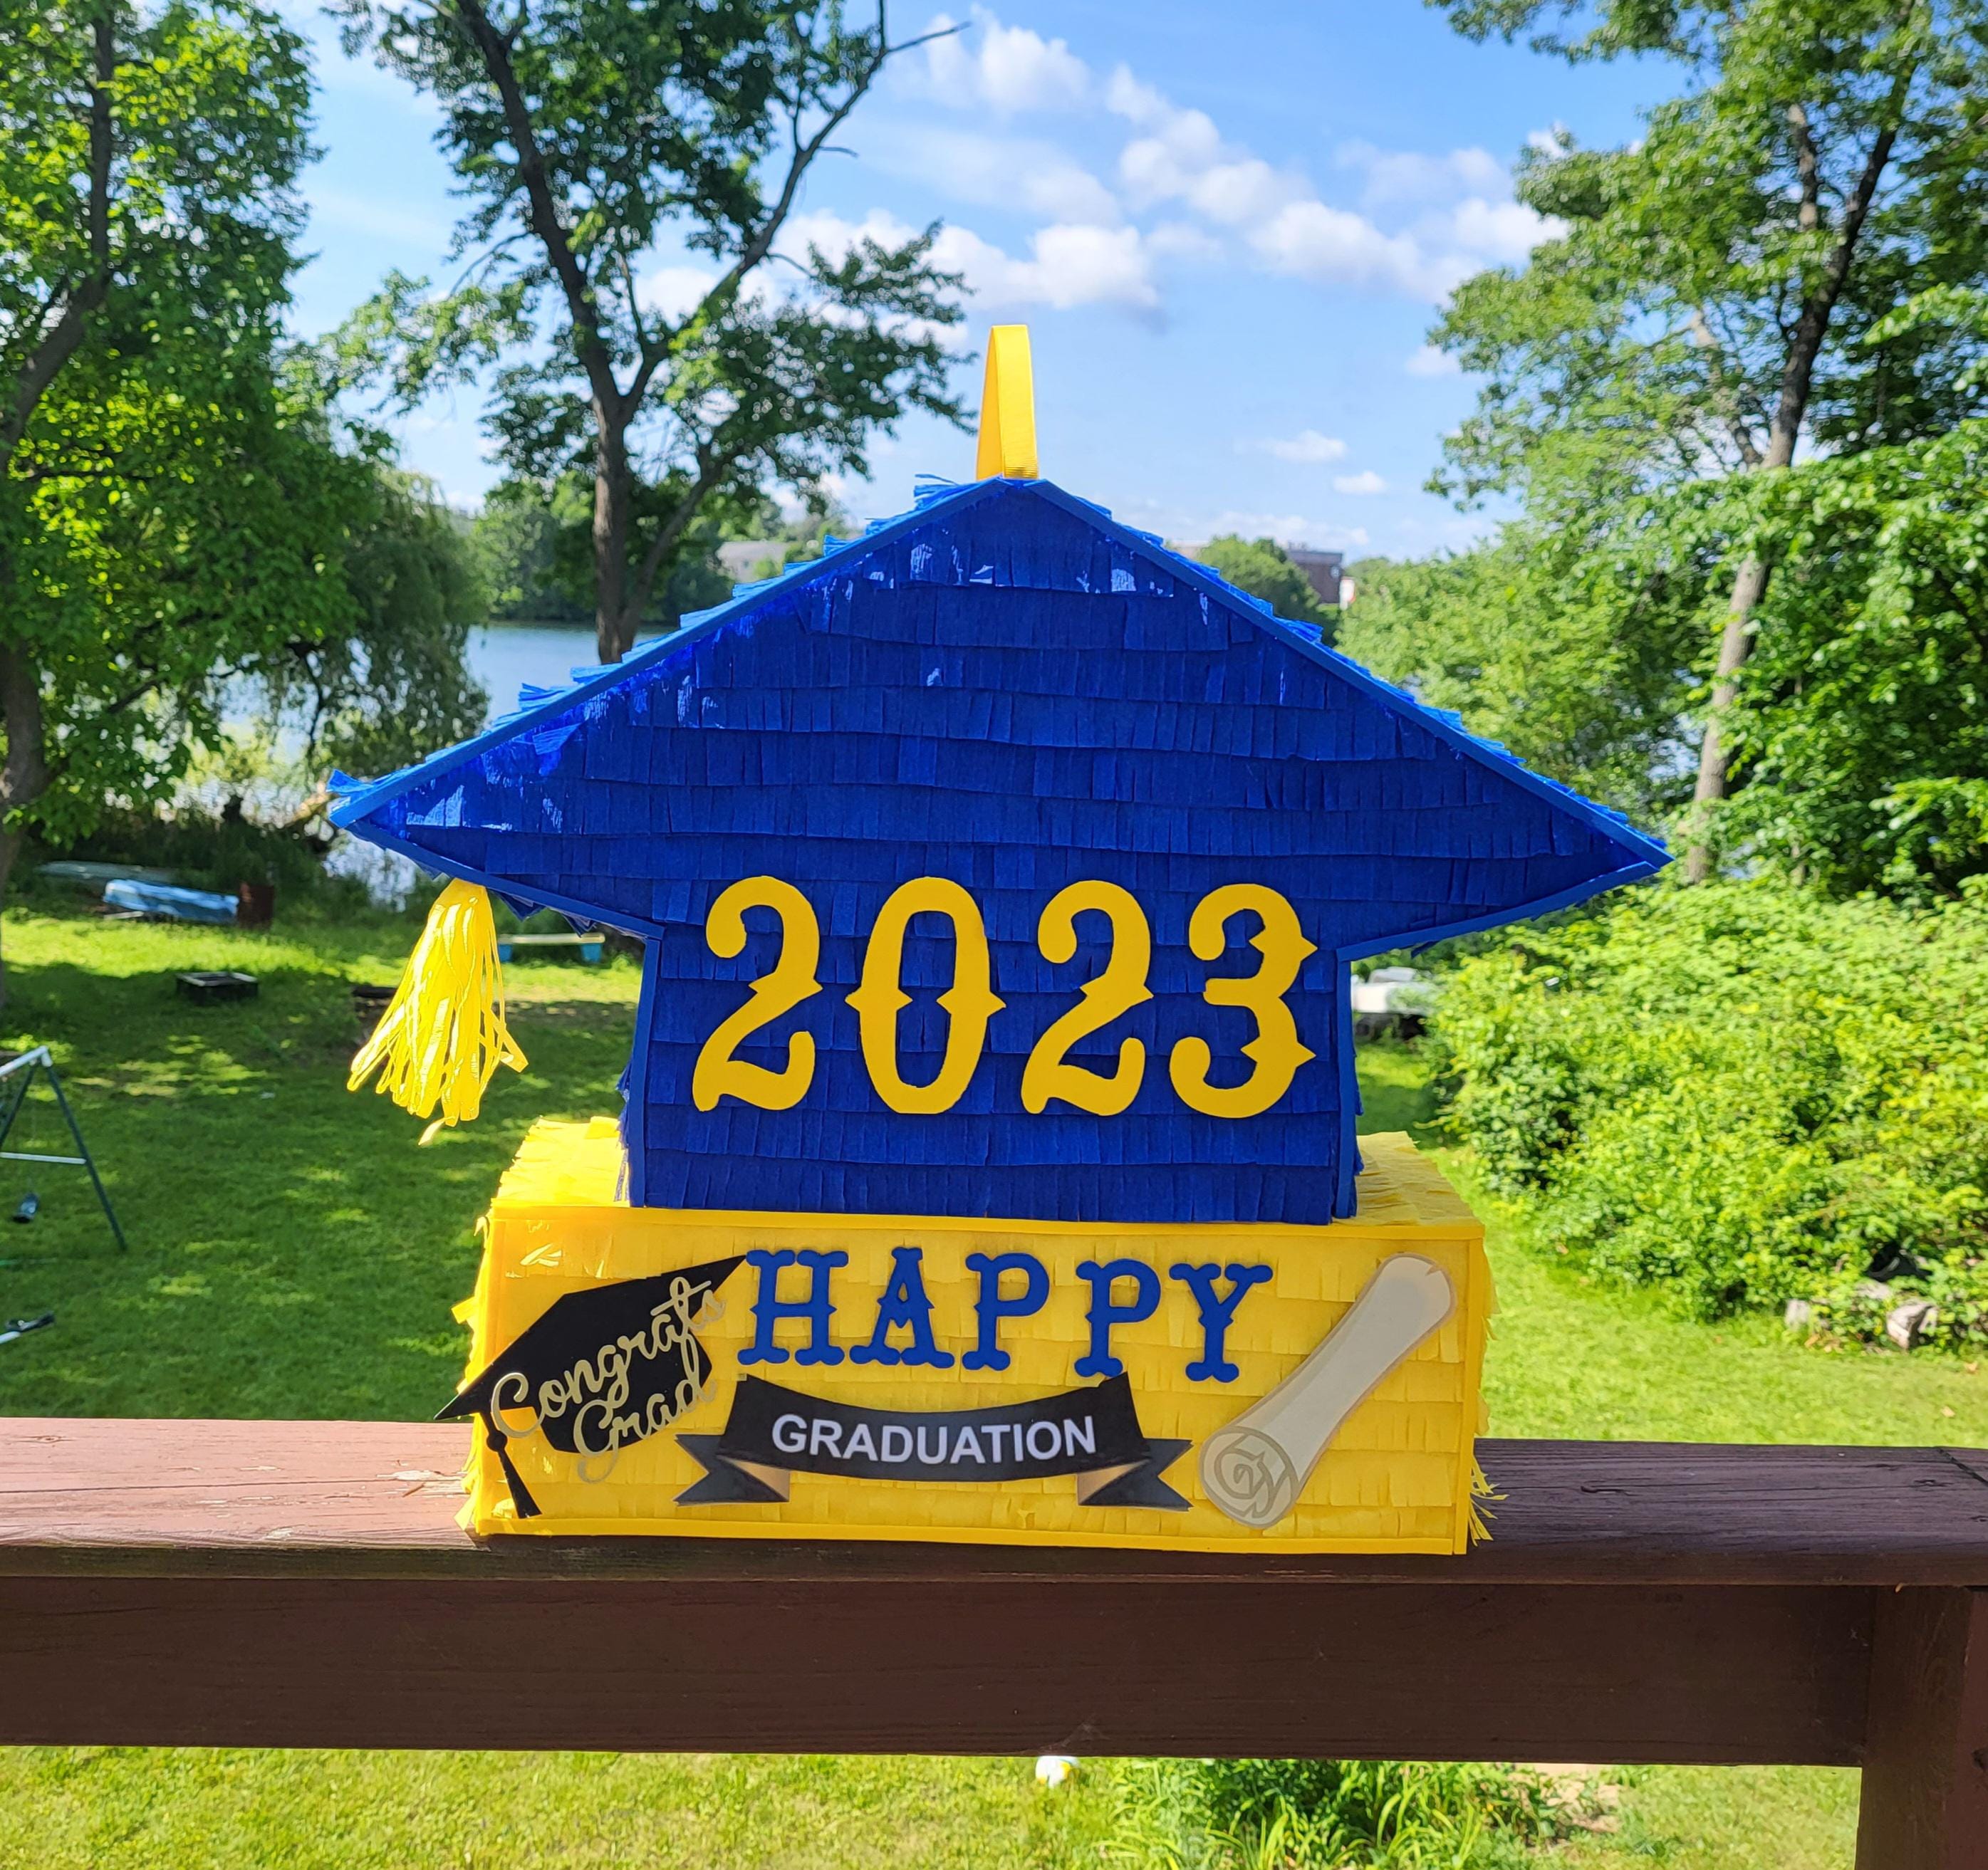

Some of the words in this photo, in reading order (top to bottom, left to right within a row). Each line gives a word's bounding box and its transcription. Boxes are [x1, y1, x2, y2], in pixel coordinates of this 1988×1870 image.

[692, 876, 1318, 1118] 2023
[491, 1277, 725, 1438] Congrats
[737, 1247, 1274, 1383] HAPPY
[573, 1326, 717, 1484] Grad
[771, 1414, 1096, 1465] GRADUATION
